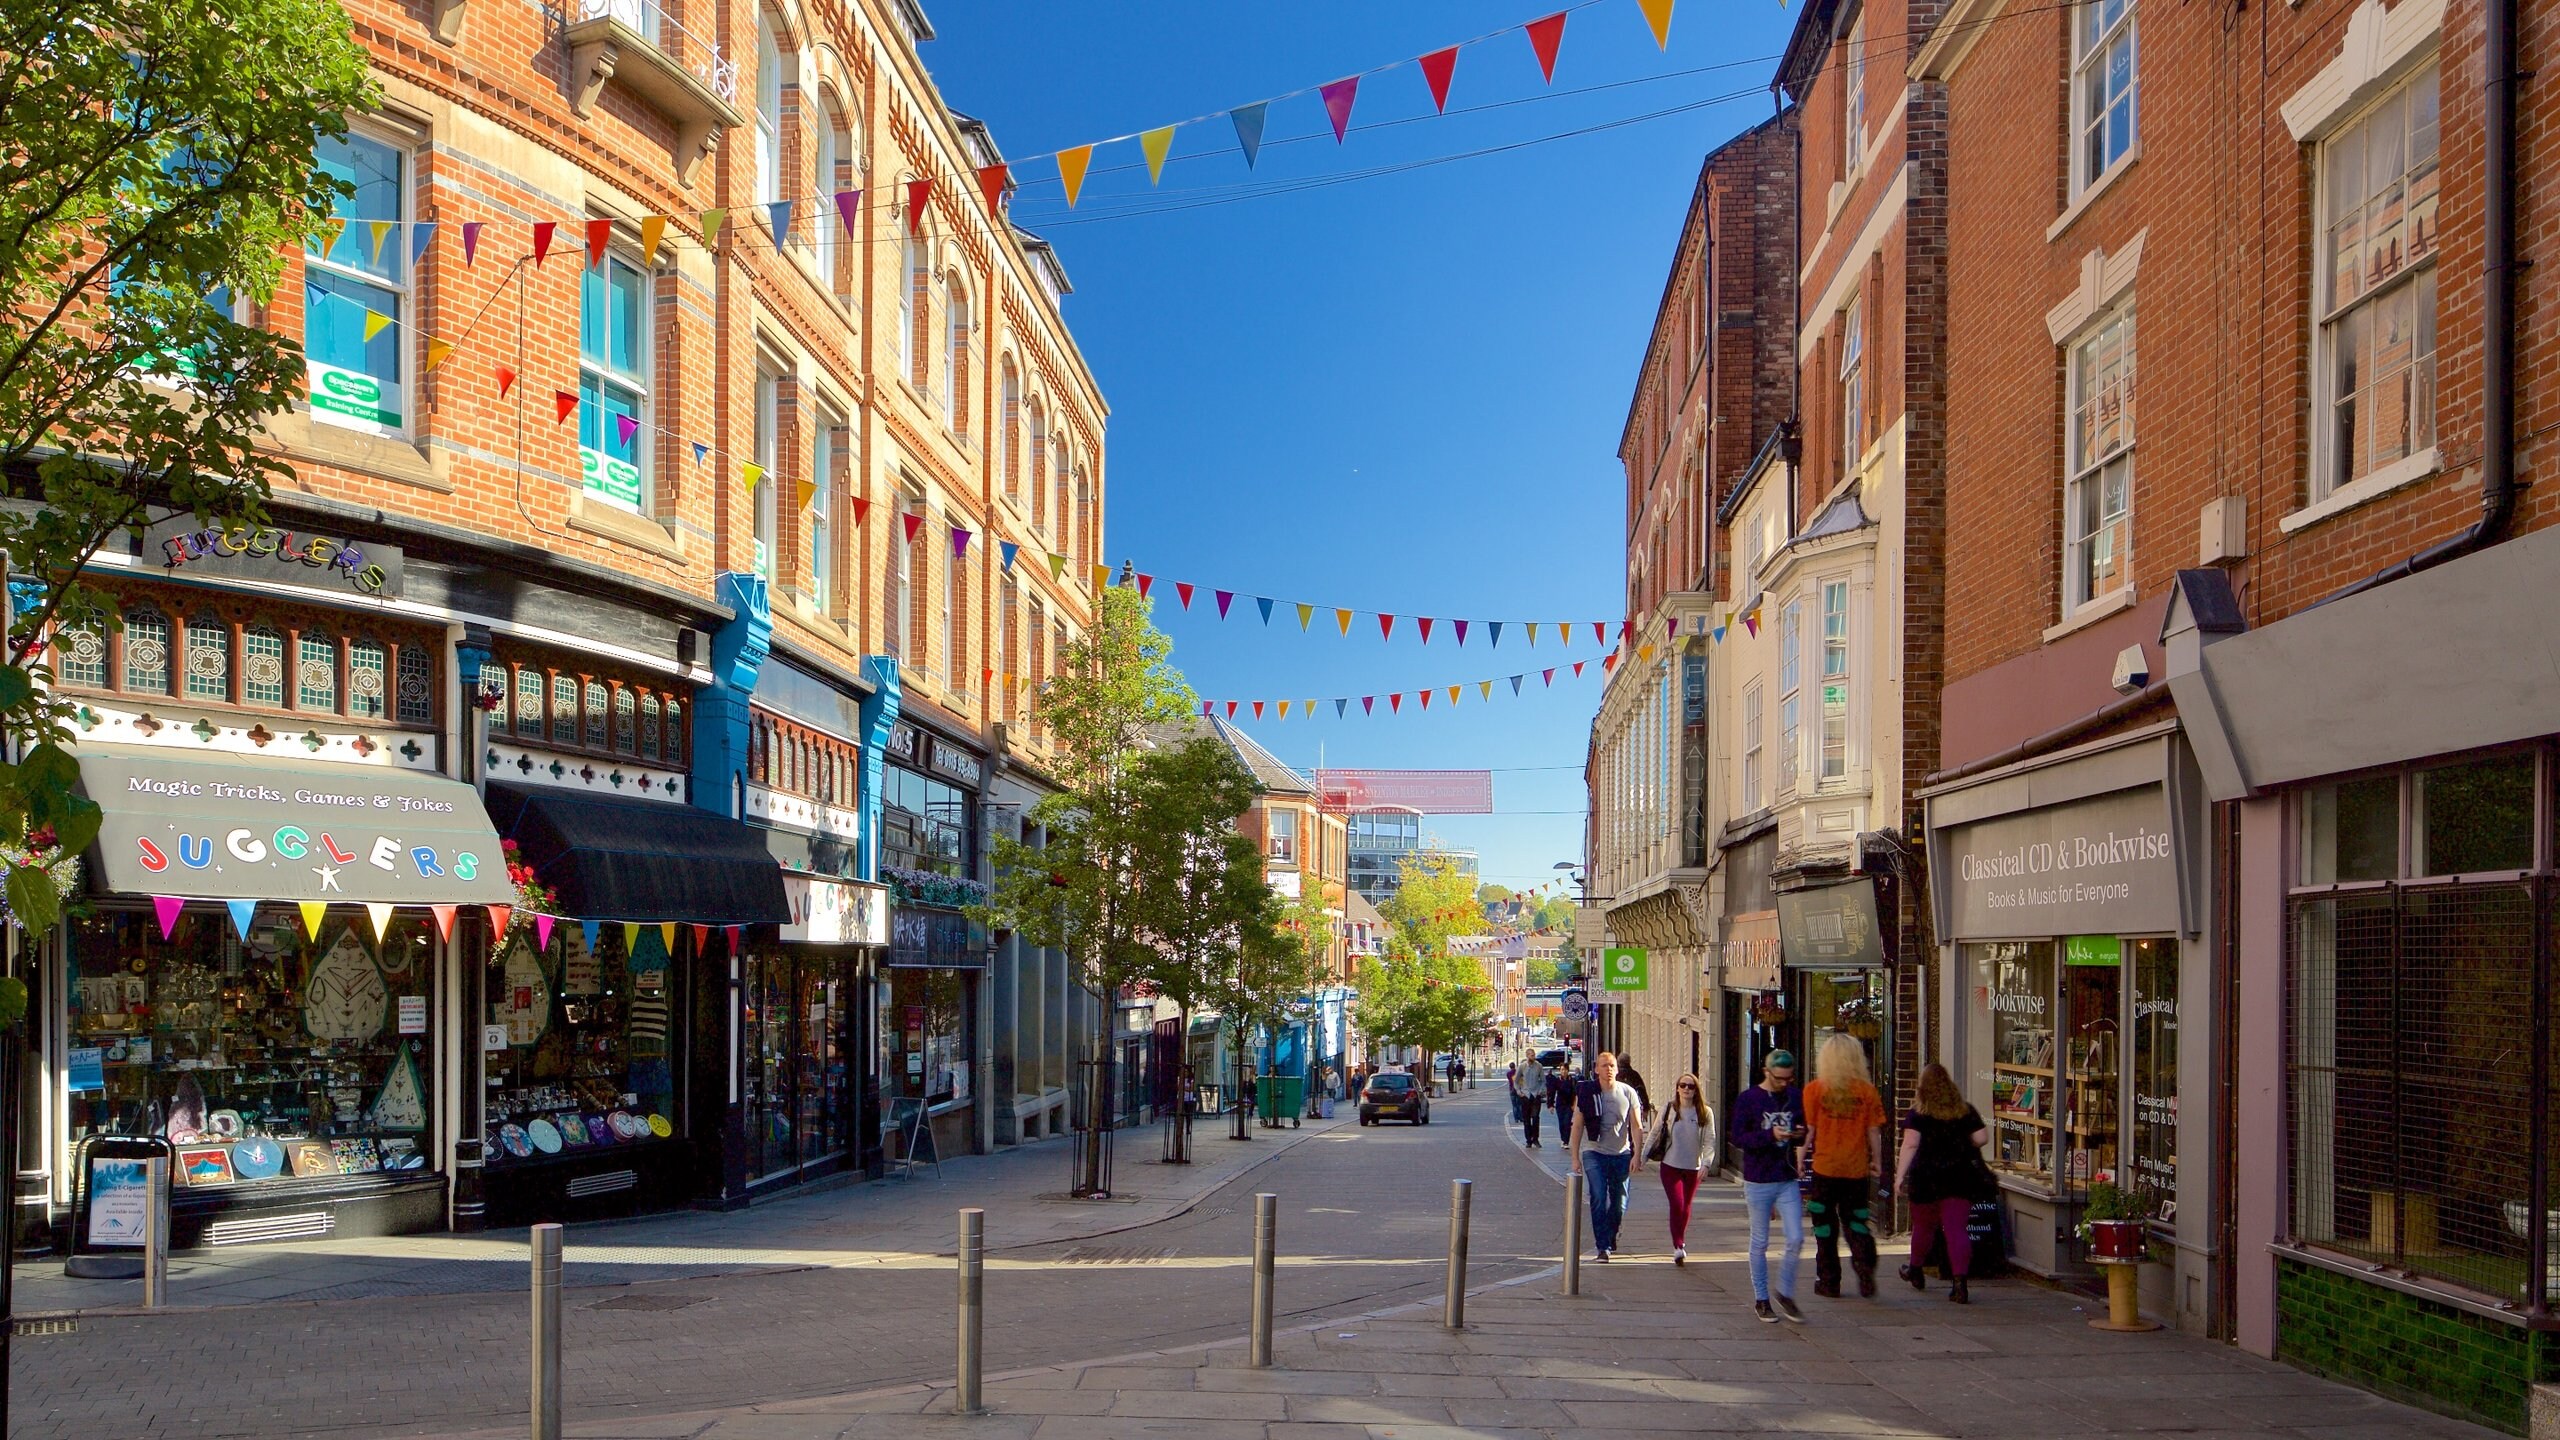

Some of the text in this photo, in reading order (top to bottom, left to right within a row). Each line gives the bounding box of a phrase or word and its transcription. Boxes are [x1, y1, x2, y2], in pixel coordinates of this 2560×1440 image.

[325, 399, 378, 418] Training Centre
[1686, 664, 1704, 861] RESTAURANT
[128, 777, 454, 813] Magic Tricks, Games & Jokes
[1962, 828, 2170, 882] Classical CD & Bookwise
[1988, 882, 2129, 908] Books & Music for Everyone
[1591, 980, 1604, 988] WHI
[1612, 976, 1640, 985] OXFAM
[1591, 988, 1608, 997] ROSE
[1988, 986, 2045, 1014] Bookwise
[2134, 996, 2174, 1019] Classical
[1996, 1072, 2012, 1084] Second
[2013, 1075, 2026, 1085] Hand
[2026, 1076, 2041, 1088] Books
[2138, 1094, 2178, 1110] Classical Mu
[1998, 1118, 2010, 1129] Hand
[2140, 1111, 2178, 1126] on CD & DV
[2140, 1156, 2174, 1174] Film Music
[118, 1184, 146, 1192] E-Cigarett
[2160, 1176, 2166, 1188] &
[1971, 1200, 1996, 1210] kwise
